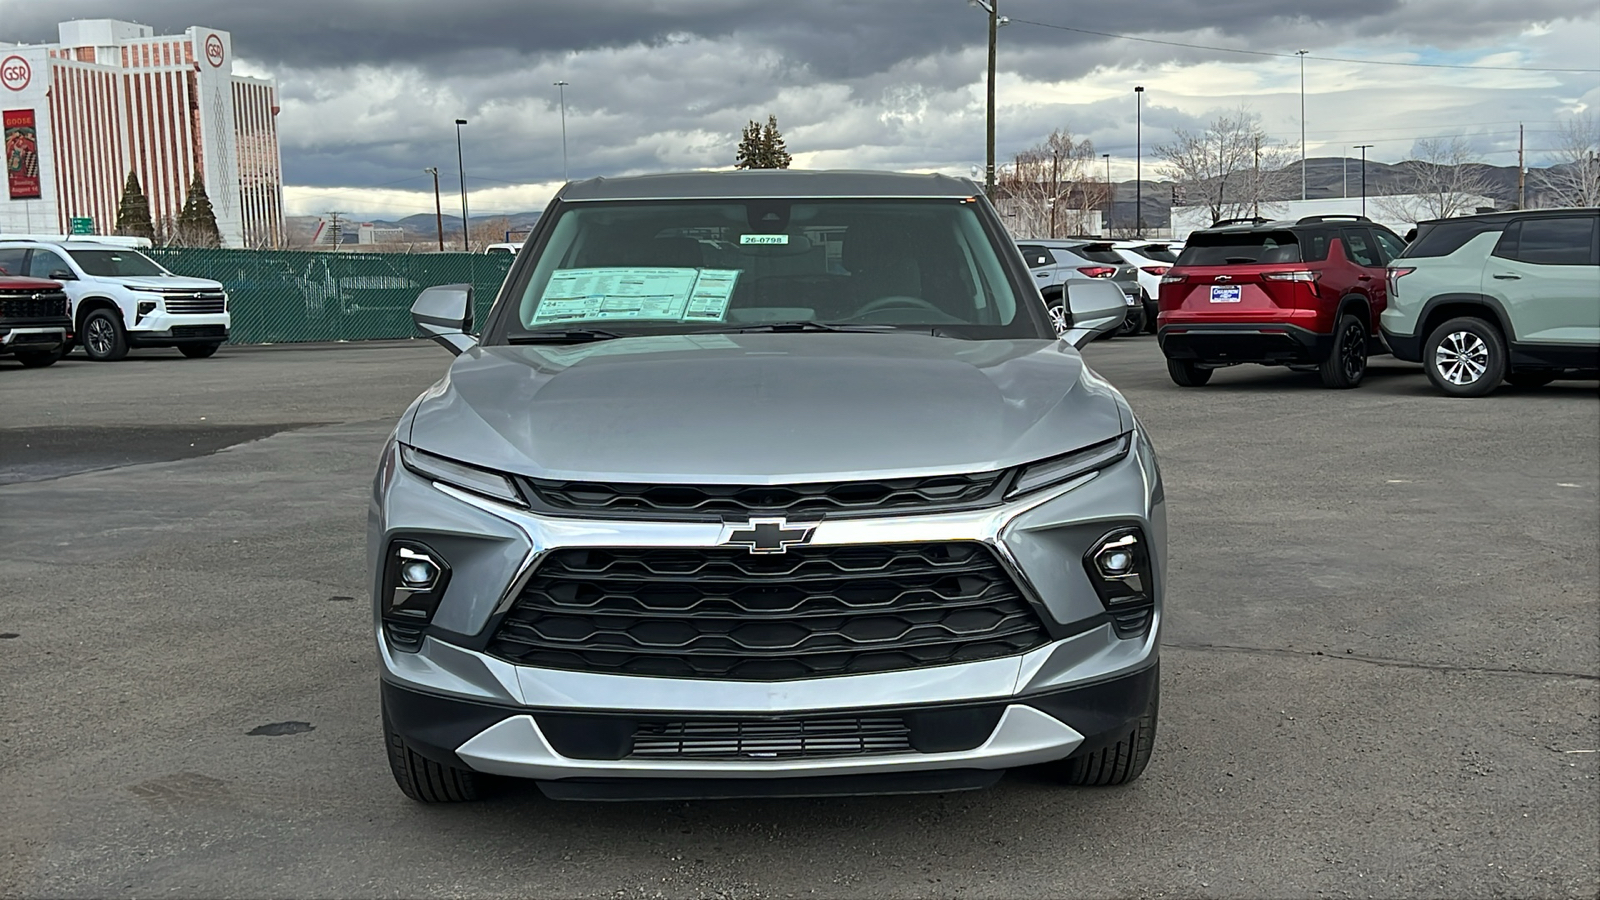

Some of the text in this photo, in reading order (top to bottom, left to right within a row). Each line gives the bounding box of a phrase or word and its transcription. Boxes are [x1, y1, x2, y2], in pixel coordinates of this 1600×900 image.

[208, 43, 222, 58] GSR
[4, 66, 26, 81] GSR
[6, 117, 32, 126] GOOSE
